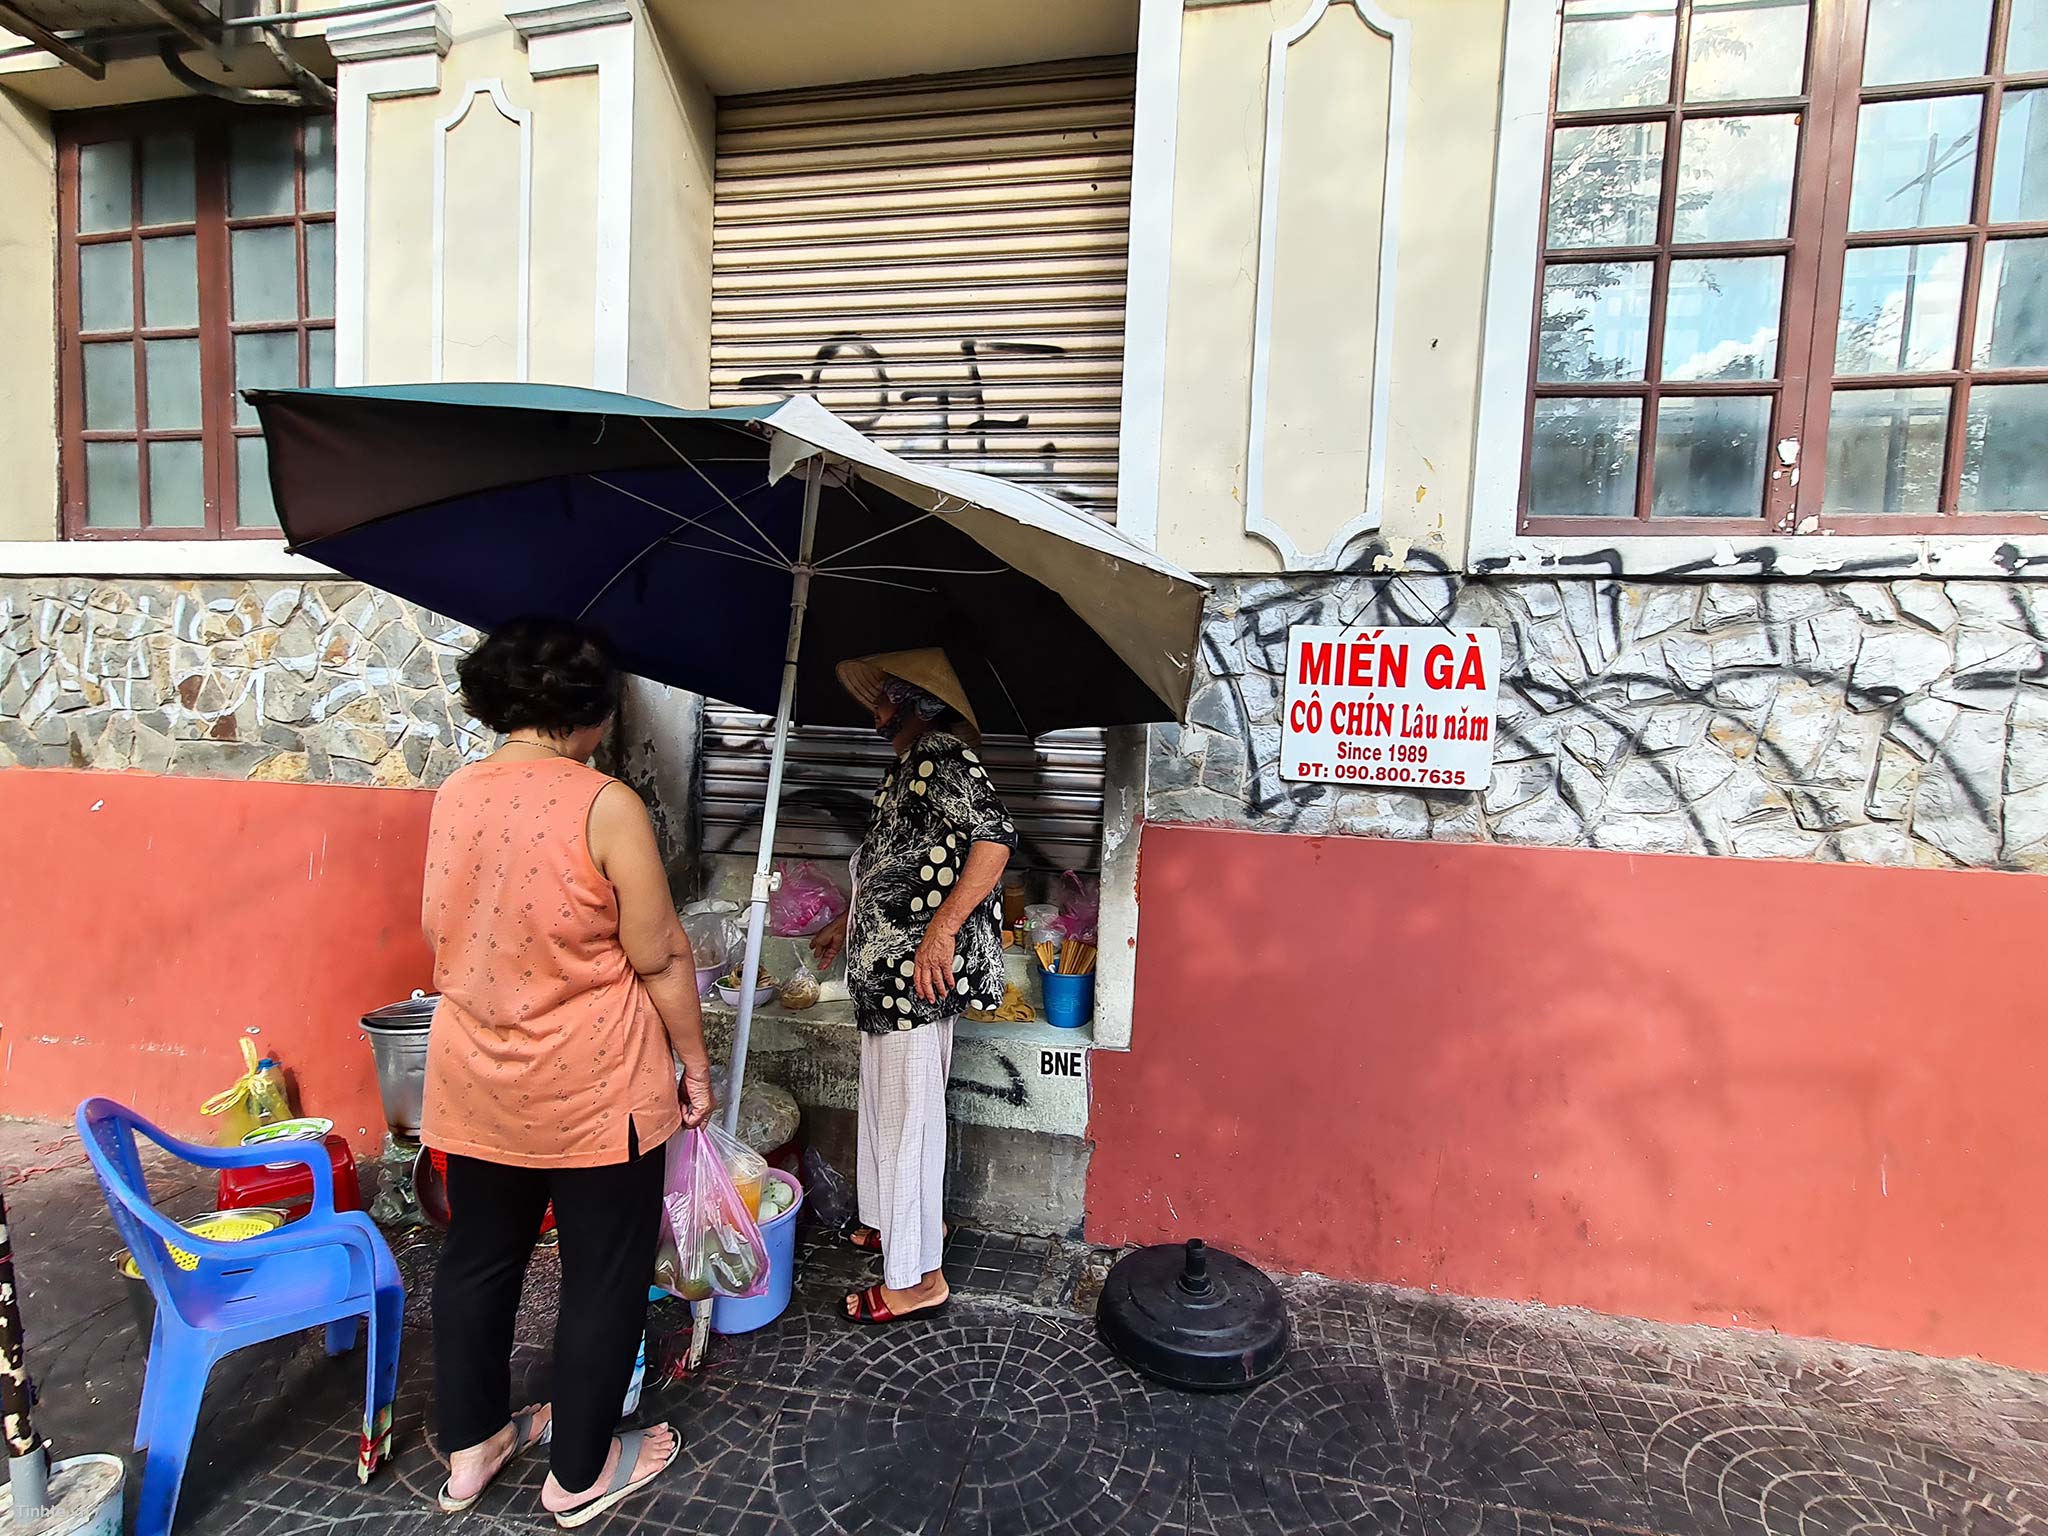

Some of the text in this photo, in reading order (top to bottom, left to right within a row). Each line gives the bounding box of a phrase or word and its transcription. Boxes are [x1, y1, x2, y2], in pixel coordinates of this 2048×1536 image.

[1299, 630, 1486, 690] MIẾN GÀ
[1290, 690, 1488, 741] CÔ CHÍN Lâu năm
[1337, 741, 1428, 763] Since 1989
[1298, 762, 1465, 785] ĐT: 090.800.7635
[1040, 1051, 1081, 1077] BNE
